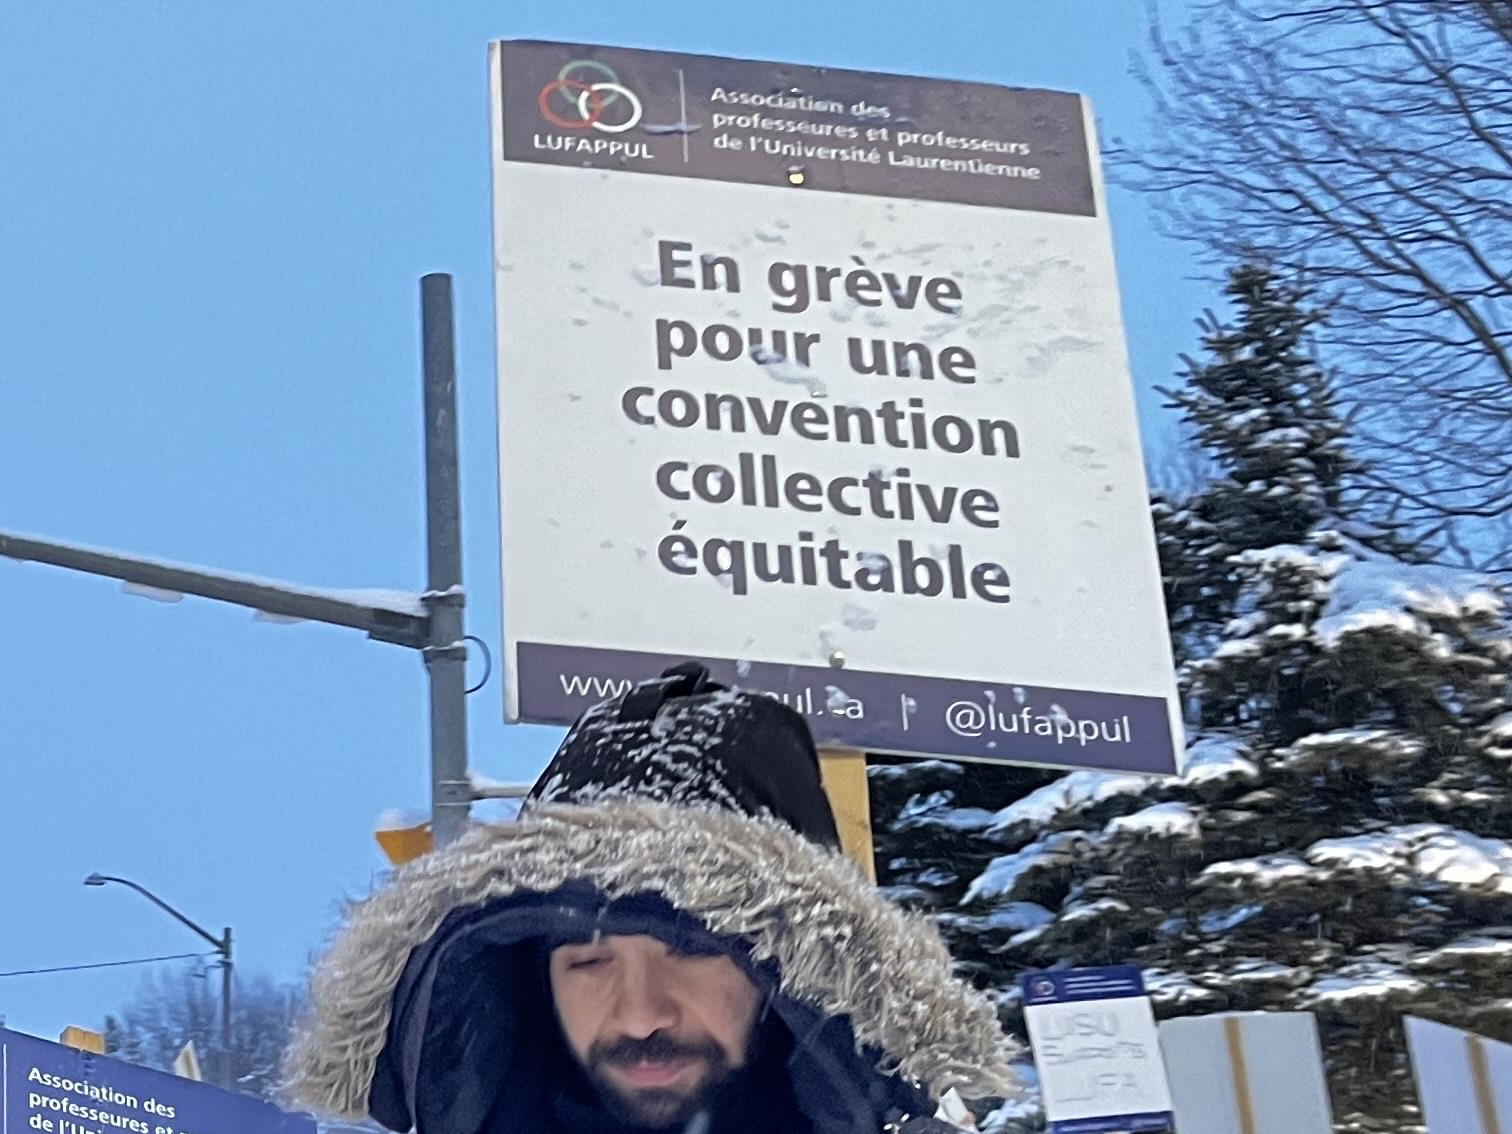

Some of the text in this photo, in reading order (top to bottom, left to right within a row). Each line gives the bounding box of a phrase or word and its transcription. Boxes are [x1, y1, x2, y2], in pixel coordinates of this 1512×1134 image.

[711, 86, 891, 119] Association des
[533, 134, 654, 159] LUFAPPUL
[711, 110, 1031, 157] professeures et professeurs
[713, 131, 1041, 181] de l'Université Laurentienne
[658, 240, 963, 315] En grève
[655, 316, 977, 385] pour une
[621, 385, 1021, 459] convention
[656, 452, 1001, 530] collective
[657, 520, 1011, 605] équitable
[945, 699, 1131, 746] @lufappul
[28, 1066, 176, 1120] Association des
[29, 1092, 150, 1134] professeures
[29, 1113, 55, 1133] de
